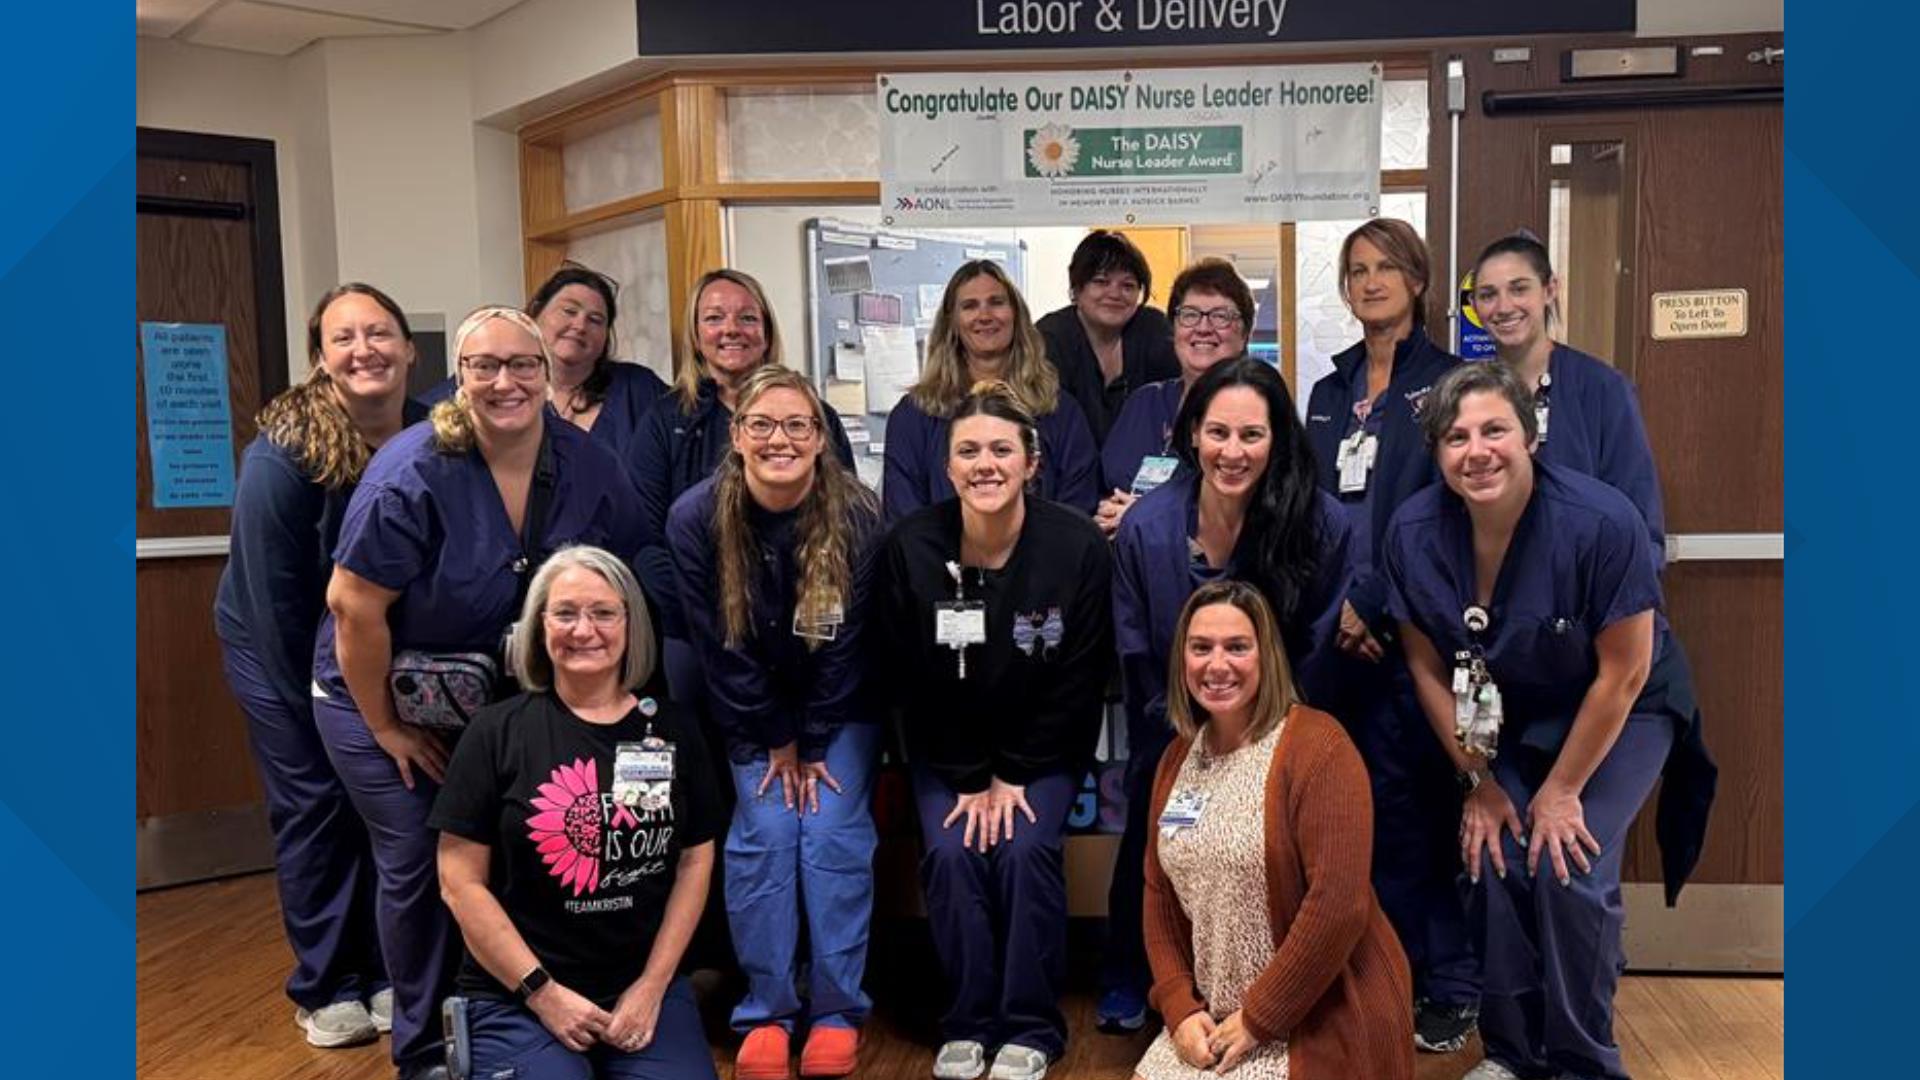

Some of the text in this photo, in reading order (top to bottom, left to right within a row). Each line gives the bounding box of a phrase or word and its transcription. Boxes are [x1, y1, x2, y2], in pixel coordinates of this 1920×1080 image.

[977, 0, 1288, 36] Labor & Delivery
[886, 78, 1375, 120] Congratulate Our DAISY Nurse Leader Honoree!
[1110, 133, 1203, 151] The DAISY
[1091, 153, 1233, 169] Nurse Leader Award
[914, 197, 954, 211] AONL
[1659, 295, 1739, 308] PRESS BUTTON
[1674, 307, 1725, 319] To Left To
[1670, 319, 1727, 332] Open Door
[605, 827, 674, 862] IS OUR
[600, 860, 666, 888] fight
[564, 895, 634, 914] #TEAMKRISTIN
